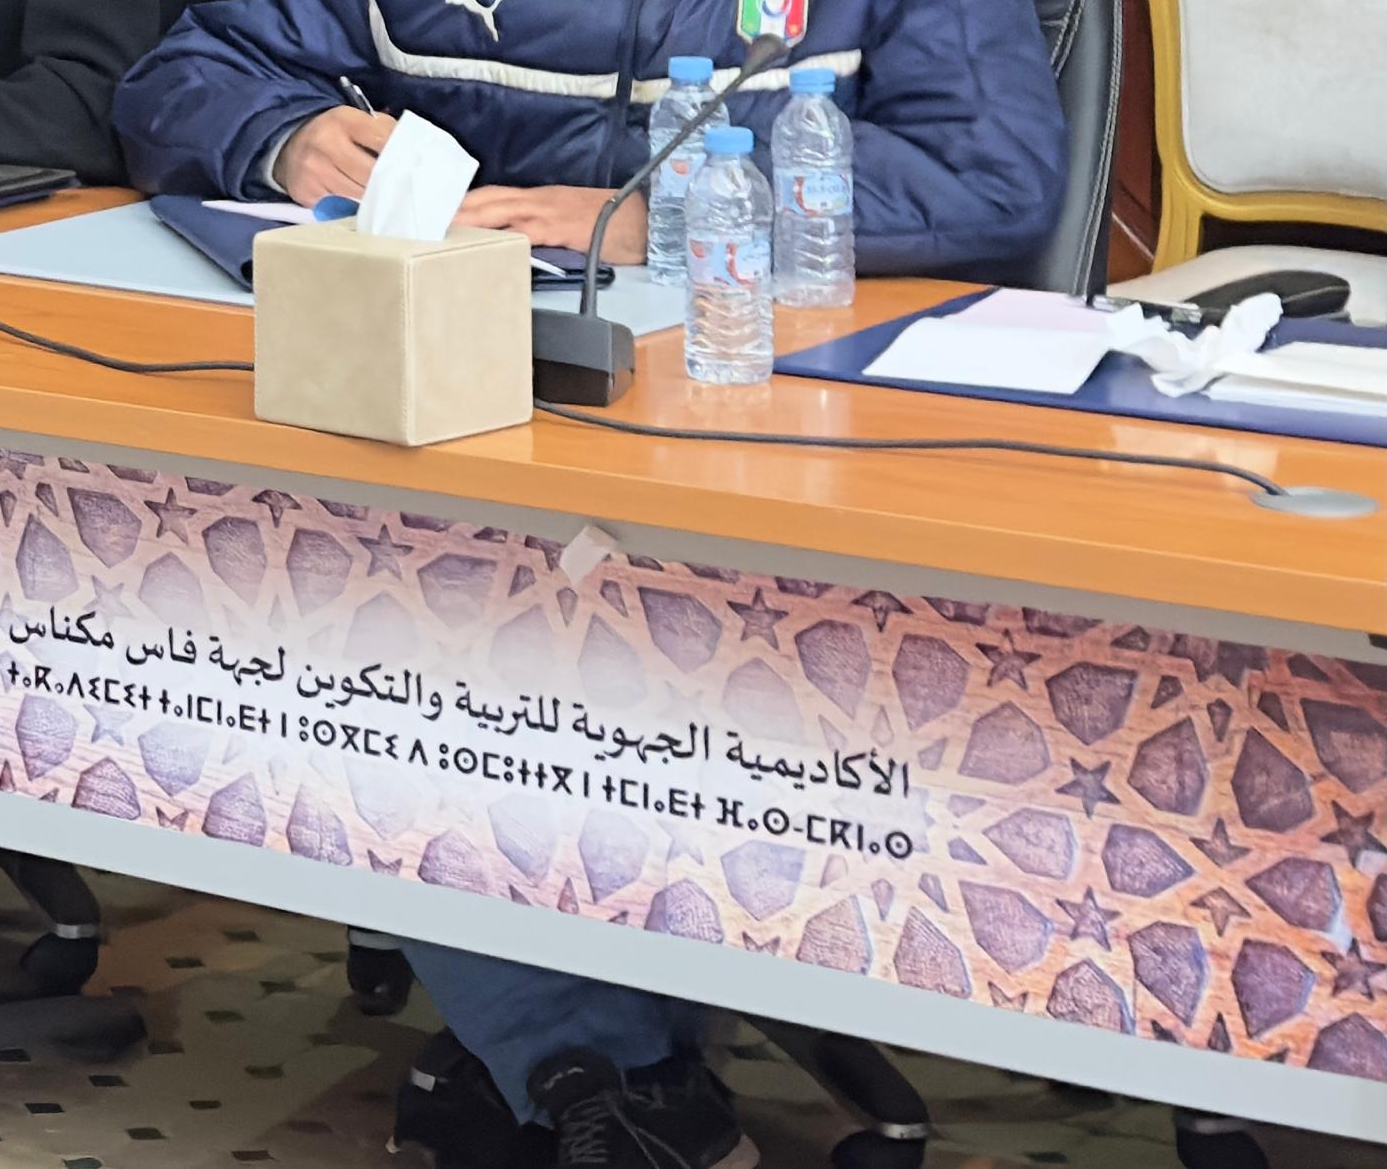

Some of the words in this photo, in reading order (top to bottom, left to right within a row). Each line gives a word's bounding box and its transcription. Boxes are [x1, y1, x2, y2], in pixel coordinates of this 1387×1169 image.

[9, 605, 115, 650] مكناس
[126, 626, 198, 665] فاس
[209, 634, 287, 687] لجهة
[296, 663, 444, 721] والتكوين
[454, 681, 561, 735] للتربية
[571, 702, 711, 764] الجهوية
[726, 731, 910, 798] الأكاديمية
